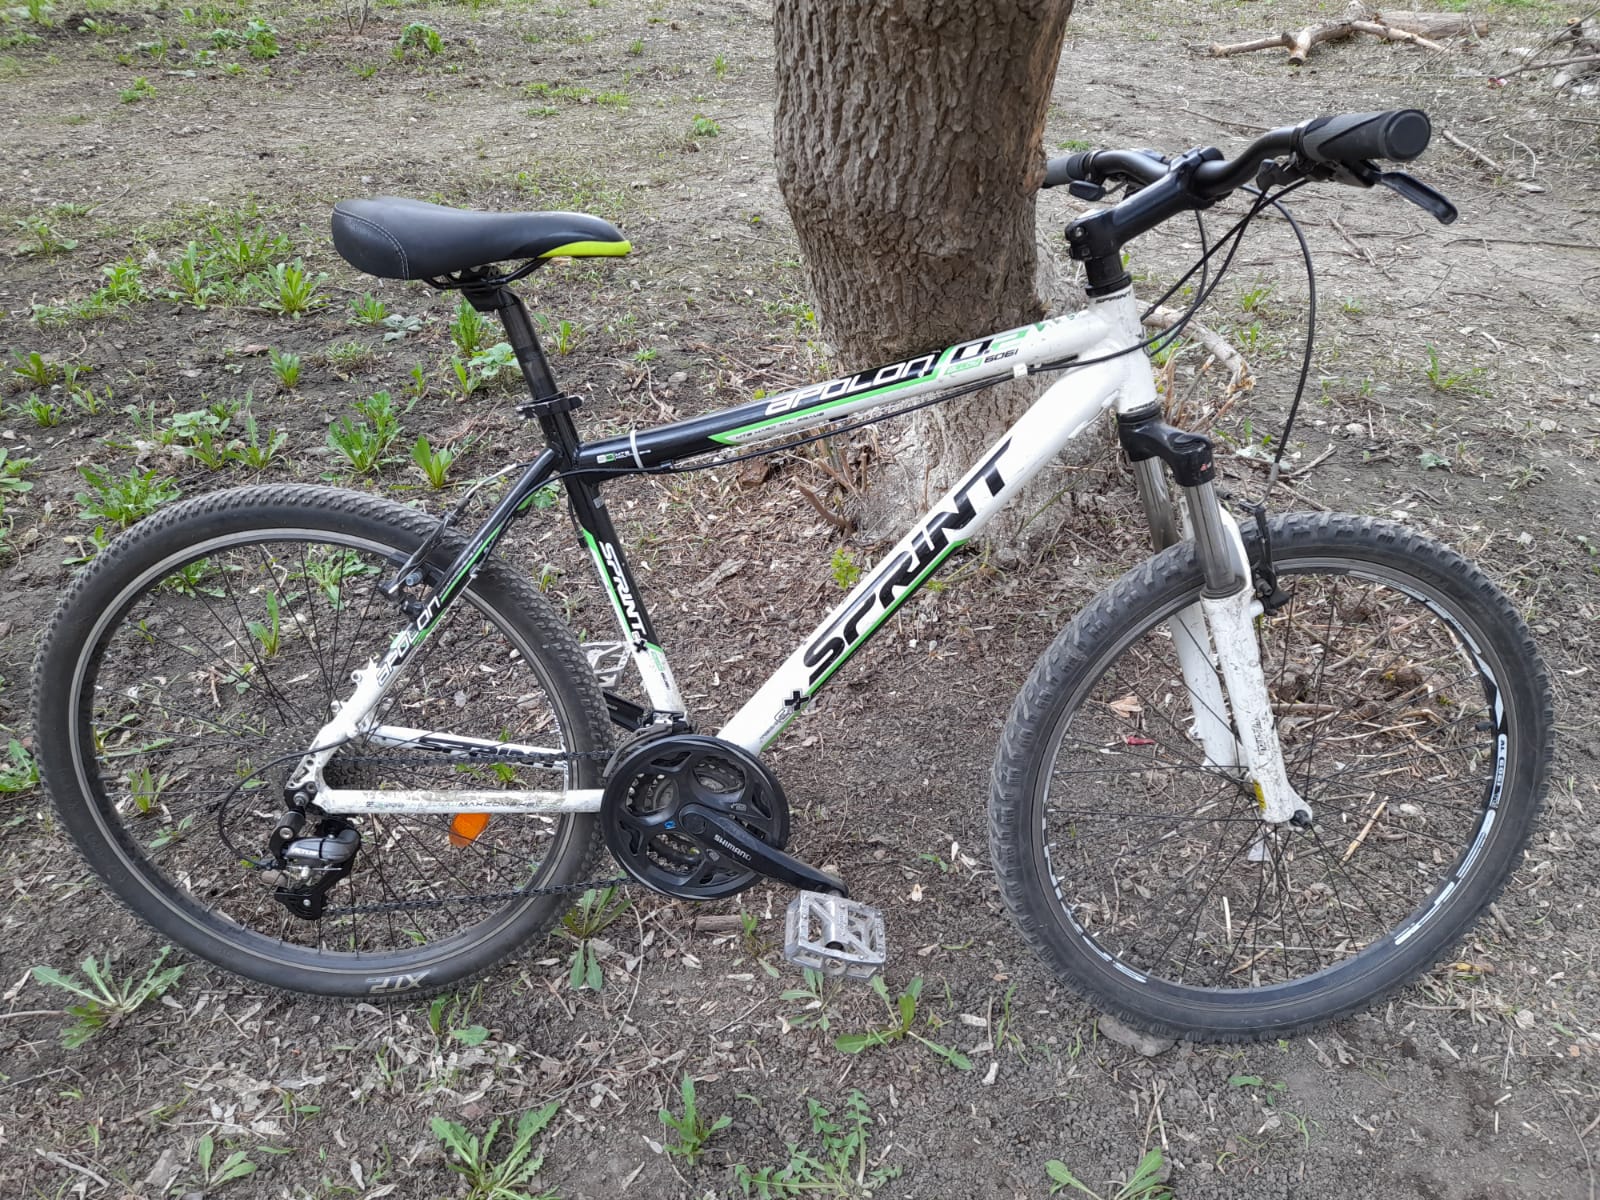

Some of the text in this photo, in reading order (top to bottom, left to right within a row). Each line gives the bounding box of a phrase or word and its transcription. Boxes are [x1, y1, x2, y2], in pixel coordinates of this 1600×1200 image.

[984, 349, 1019, 363] 6061
[600, 541, 647, 635] SPRINT
[804, 436, 1013, 686] SPRINT
[713, 834, 752, 861] SHIMANO
